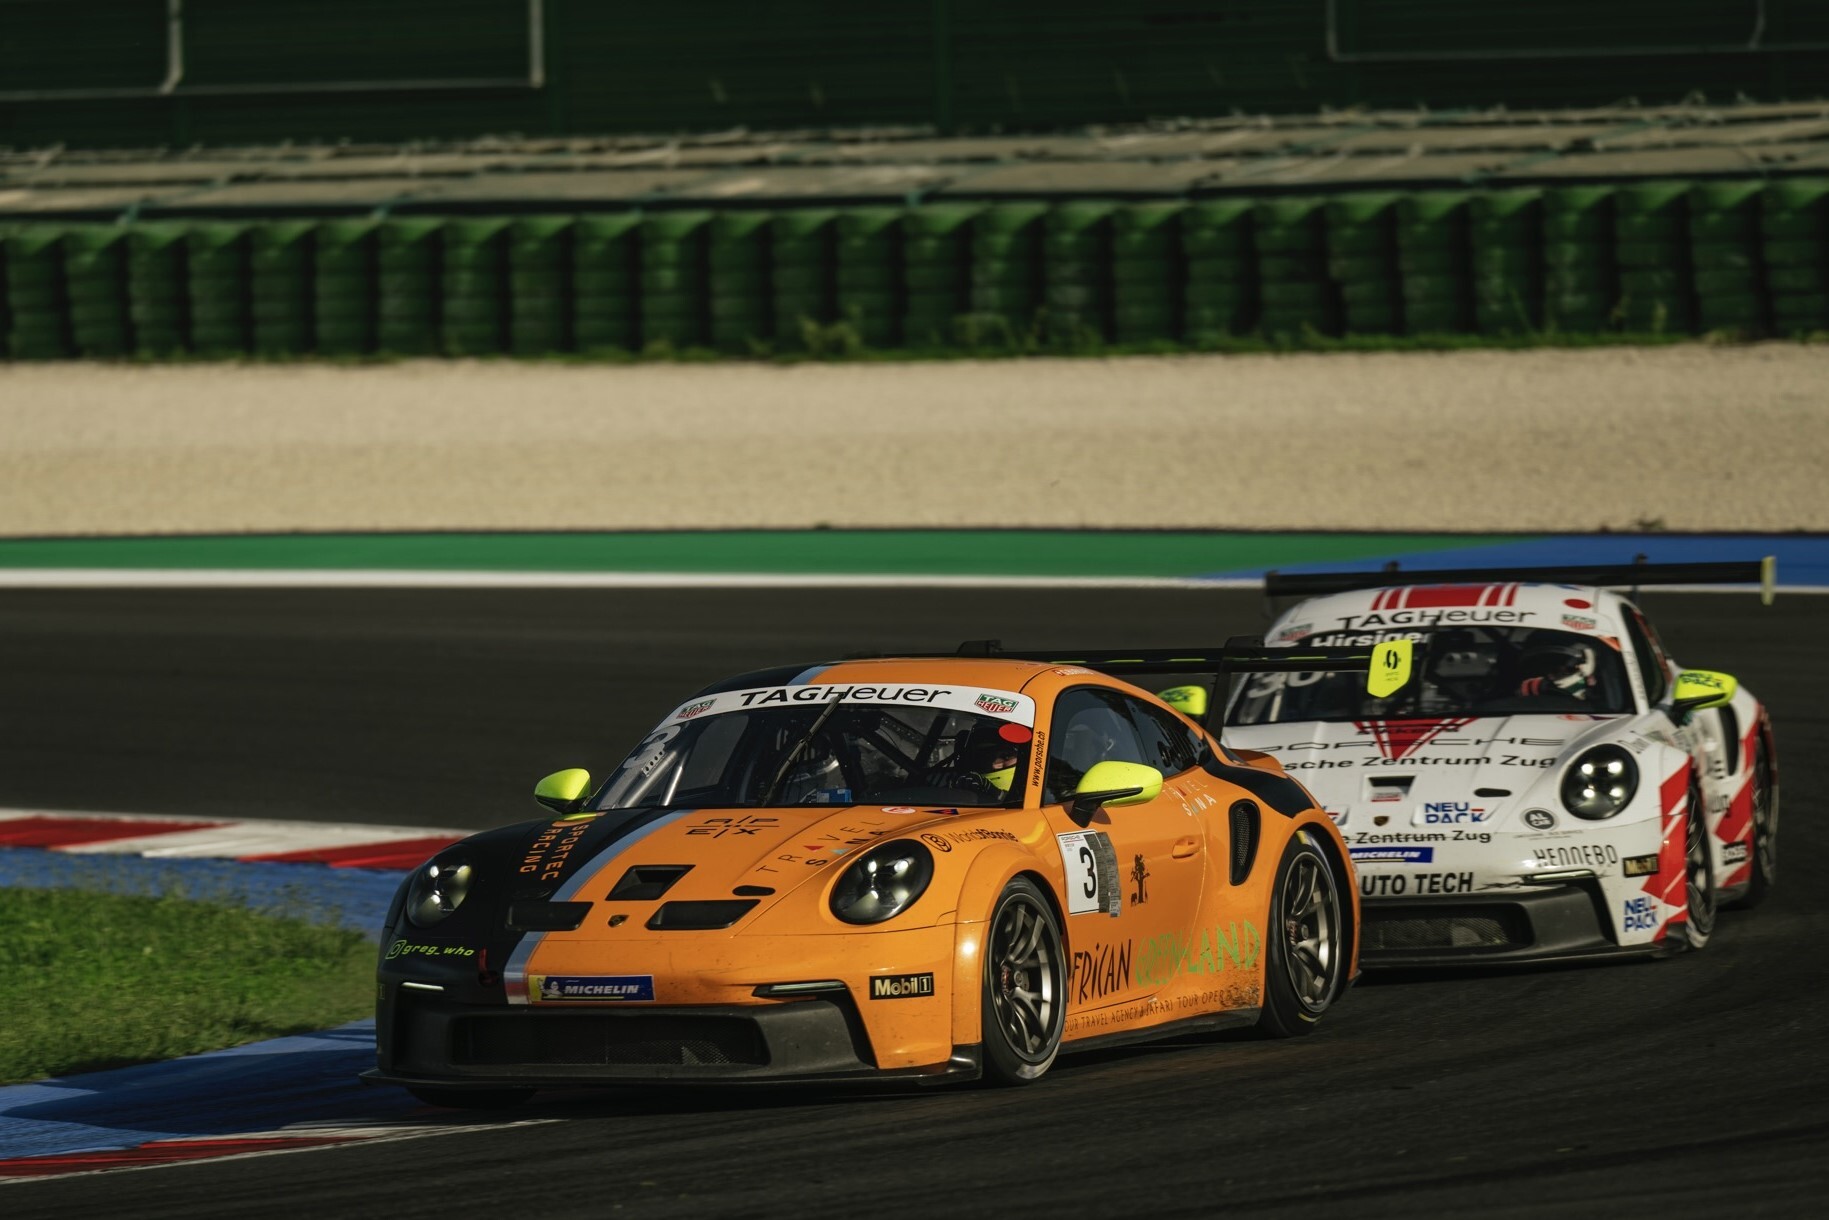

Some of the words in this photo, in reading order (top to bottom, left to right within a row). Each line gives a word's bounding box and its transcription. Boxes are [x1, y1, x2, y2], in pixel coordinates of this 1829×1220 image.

[976, 701, 1012, 713] HEUER
[983, 695, 1013, 707] TAG
[1031, 730, 1046, 787] www.porsche.ch
[1284, 759, 1354, 771] sche
[1362, 756, 1490, 767] Zentrum
[1501, 755, 1557, 769] Zug
[1356, 832, 1446, 844] Zentrum
[1453, 830, 1491, 844] Zug
[519, 828, 564, 873] RACING
[541, 824, 589, 881] SPORTEC
[1351, 851, 1421, 859] MICHELIN
[1079, 846, 1097, 899] 3
[1361, 874, 1407, 896] UTO
[1415, 871, 1474, 895] TECH
[563, 983, 641, 996] MICHELIN
[875, 978, 918, 997] Mobil
[1081, 1013, 1108, 1029] TRAVEL
[1112, 1006, 1139, 1023] AGENCY
[1177, 993, 1198, 1009] TOUR
